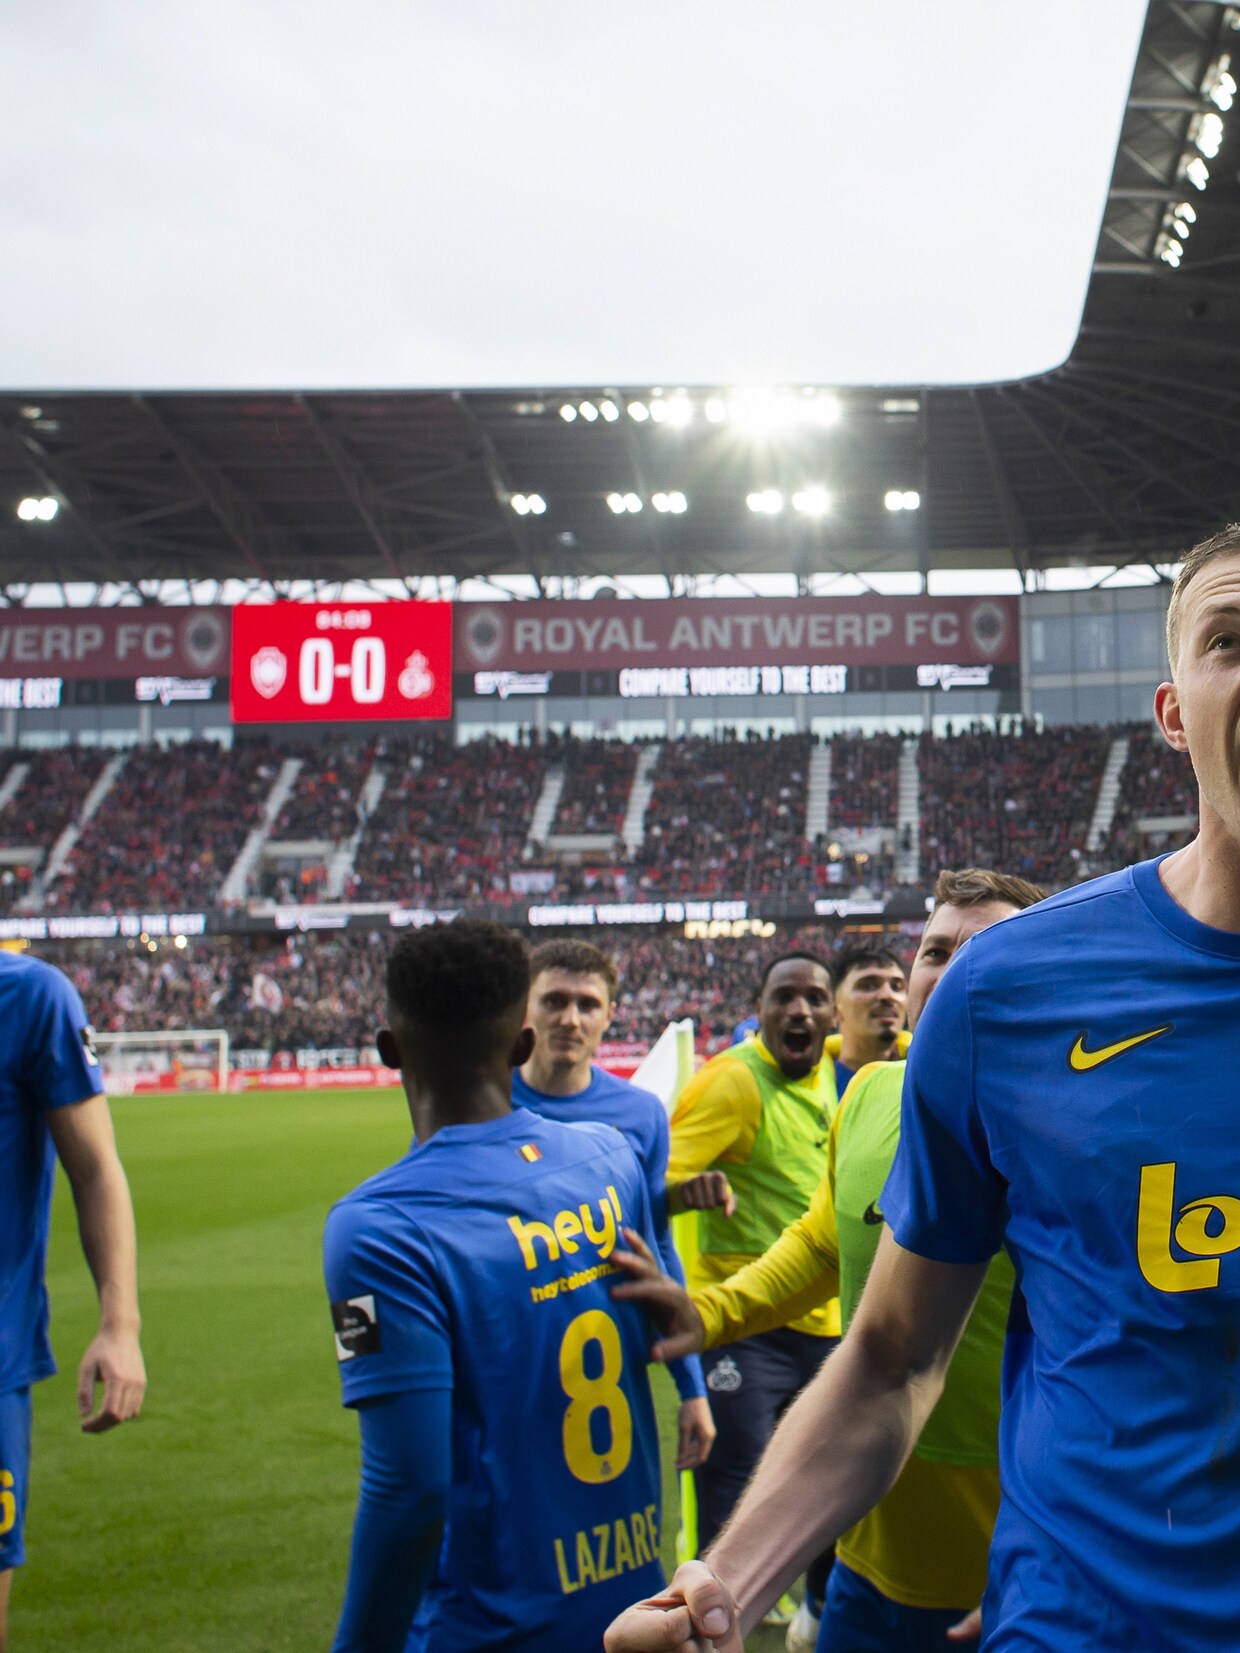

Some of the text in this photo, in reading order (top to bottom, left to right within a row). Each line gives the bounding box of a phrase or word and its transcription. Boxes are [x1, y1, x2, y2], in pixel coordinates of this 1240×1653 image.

[116, 623, 174, 661] FC
[514, 613, 960, 652] ROYAL ANTWERP FC
[300, 637, 386, 704] 0-0
[690, 667, 760, 695] YOURSELF
[761, 666, 782, 694] TO
[782, 665, 811, 694] THE
[811, 665, 848, 693] BEST
[665, 902, 684, 922] TO
[685, 901, 711, 921] THE
[507, 1185, 623, 1270] hey!
[559, 1309, 632, 1484] 8
[554, 1504, 661, 1594] LAZARE
